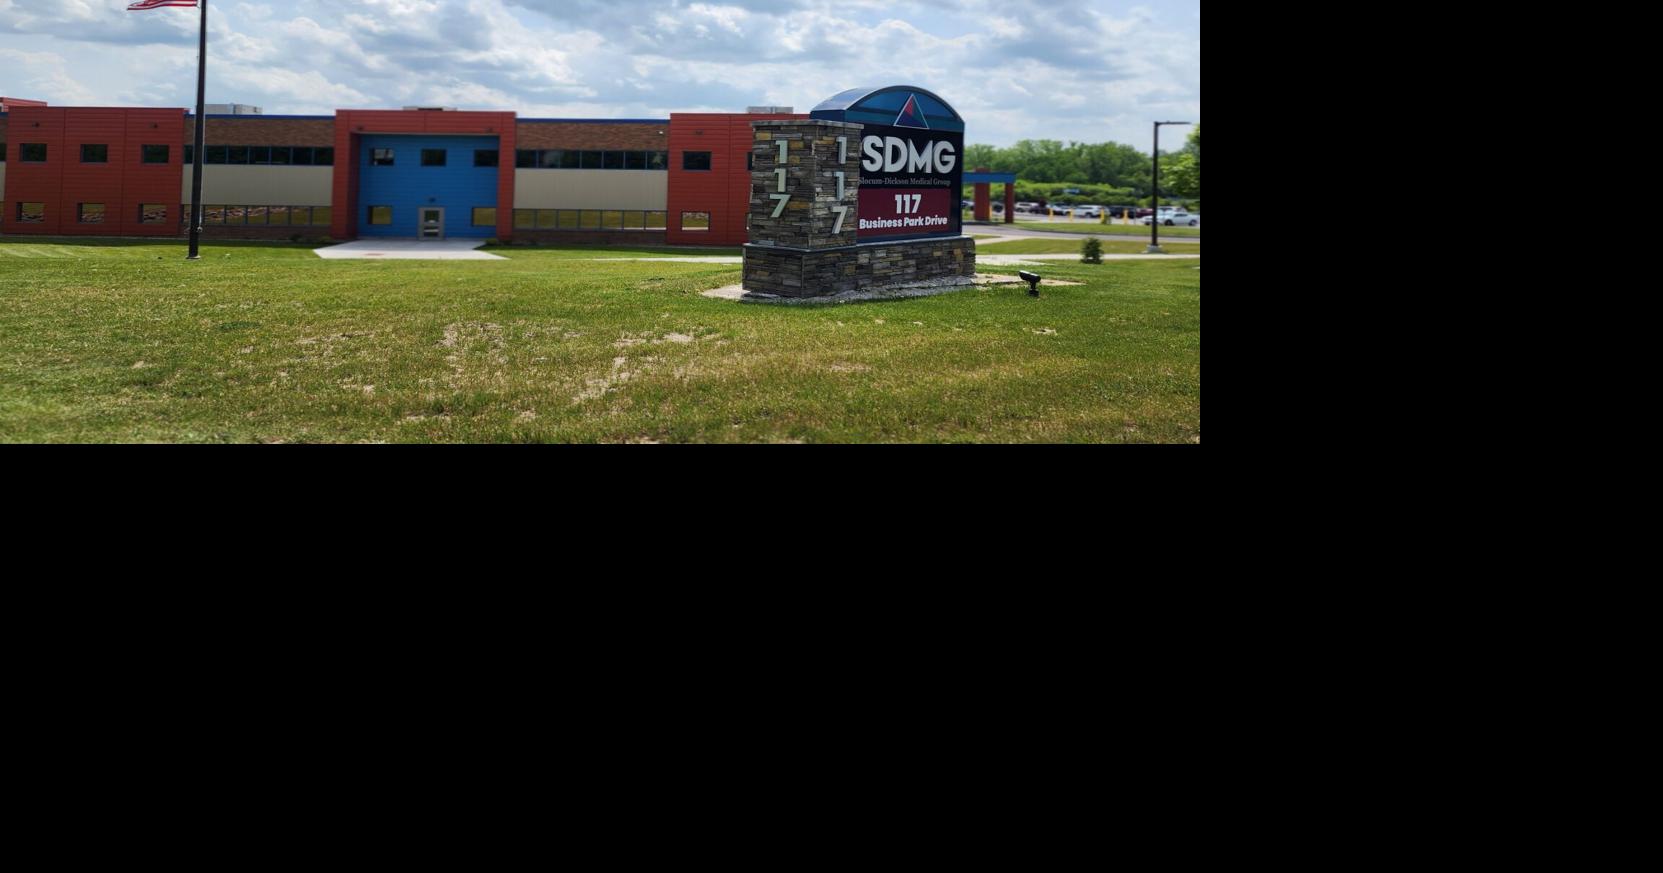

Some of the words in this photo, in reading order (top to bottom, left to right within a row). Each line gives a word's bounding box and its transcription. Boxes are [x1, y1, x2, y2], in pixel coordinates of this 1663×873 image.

[862, 135, 956, 174] SDMG
[933, 178, 951, 187] Group
[895, 194, 922, 214] 117
[859, 217, 902, 230] Business
[903, 216, 924, 227] Park
[924, 215, 948, 226] Drive
